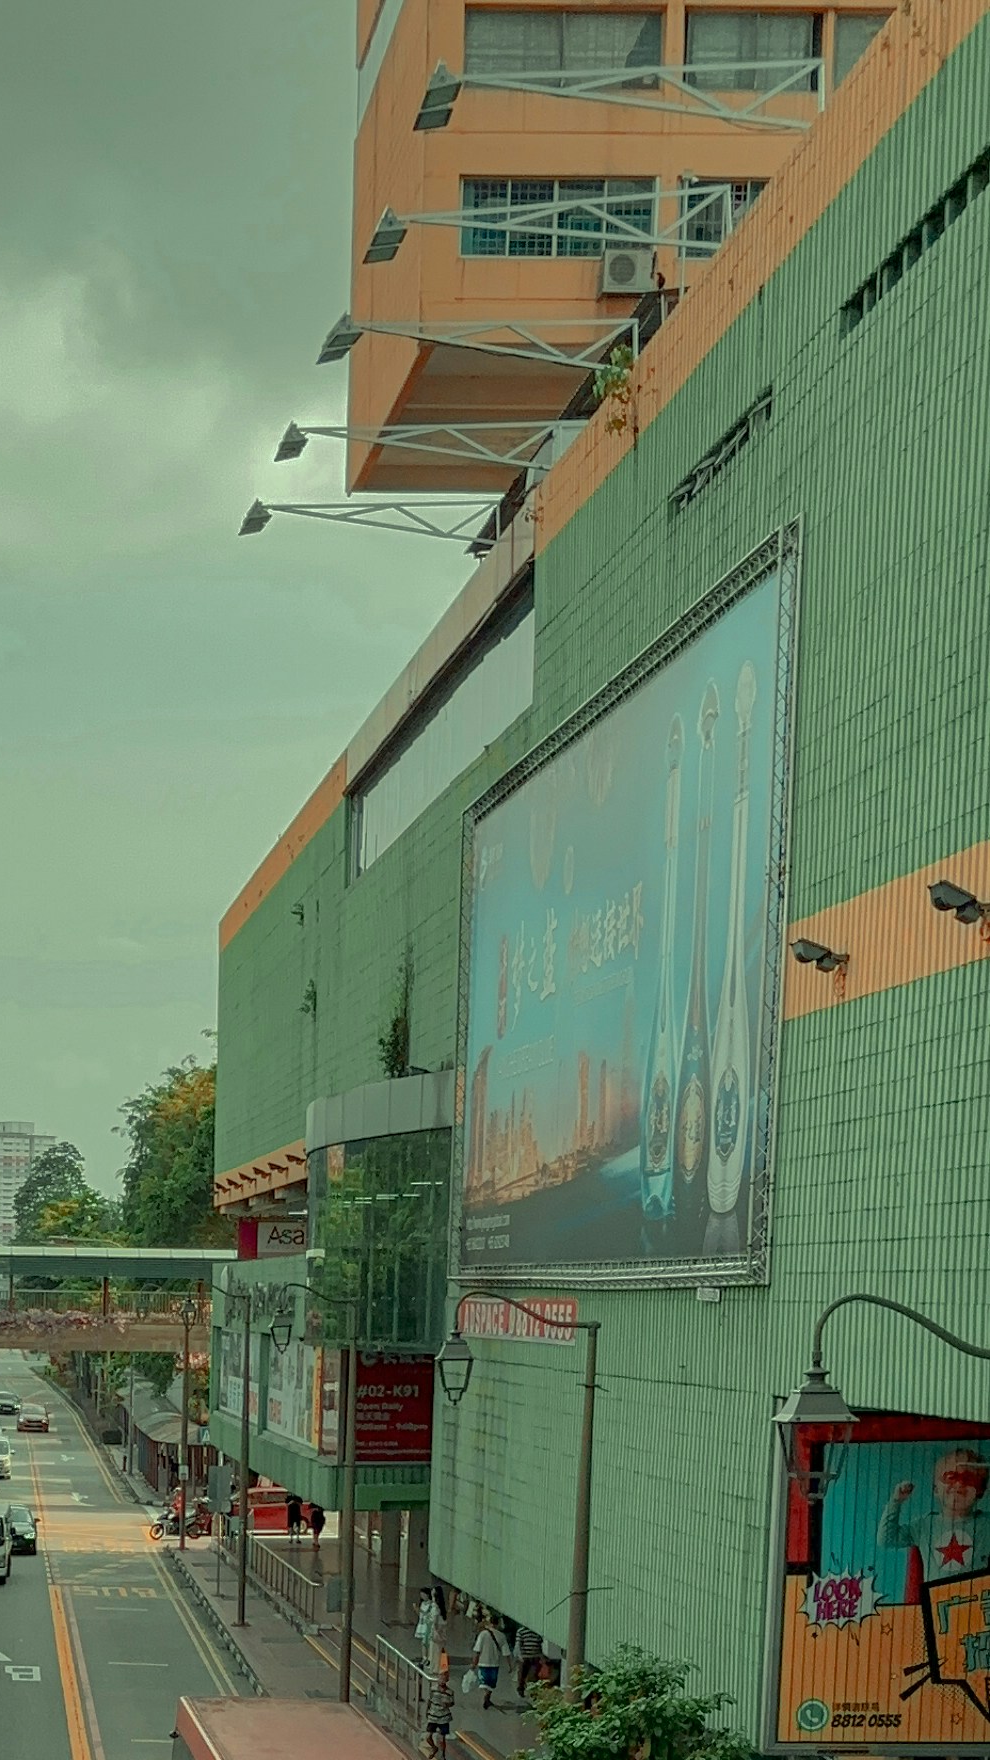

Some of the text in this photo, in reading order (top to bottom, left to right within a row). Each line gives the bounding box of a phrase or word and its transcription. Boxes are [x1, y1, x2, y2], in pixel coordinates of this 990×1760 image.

[816, 1599, 858, 1621] HERE
[831, 1713, 902, 1728] 8812 0555
